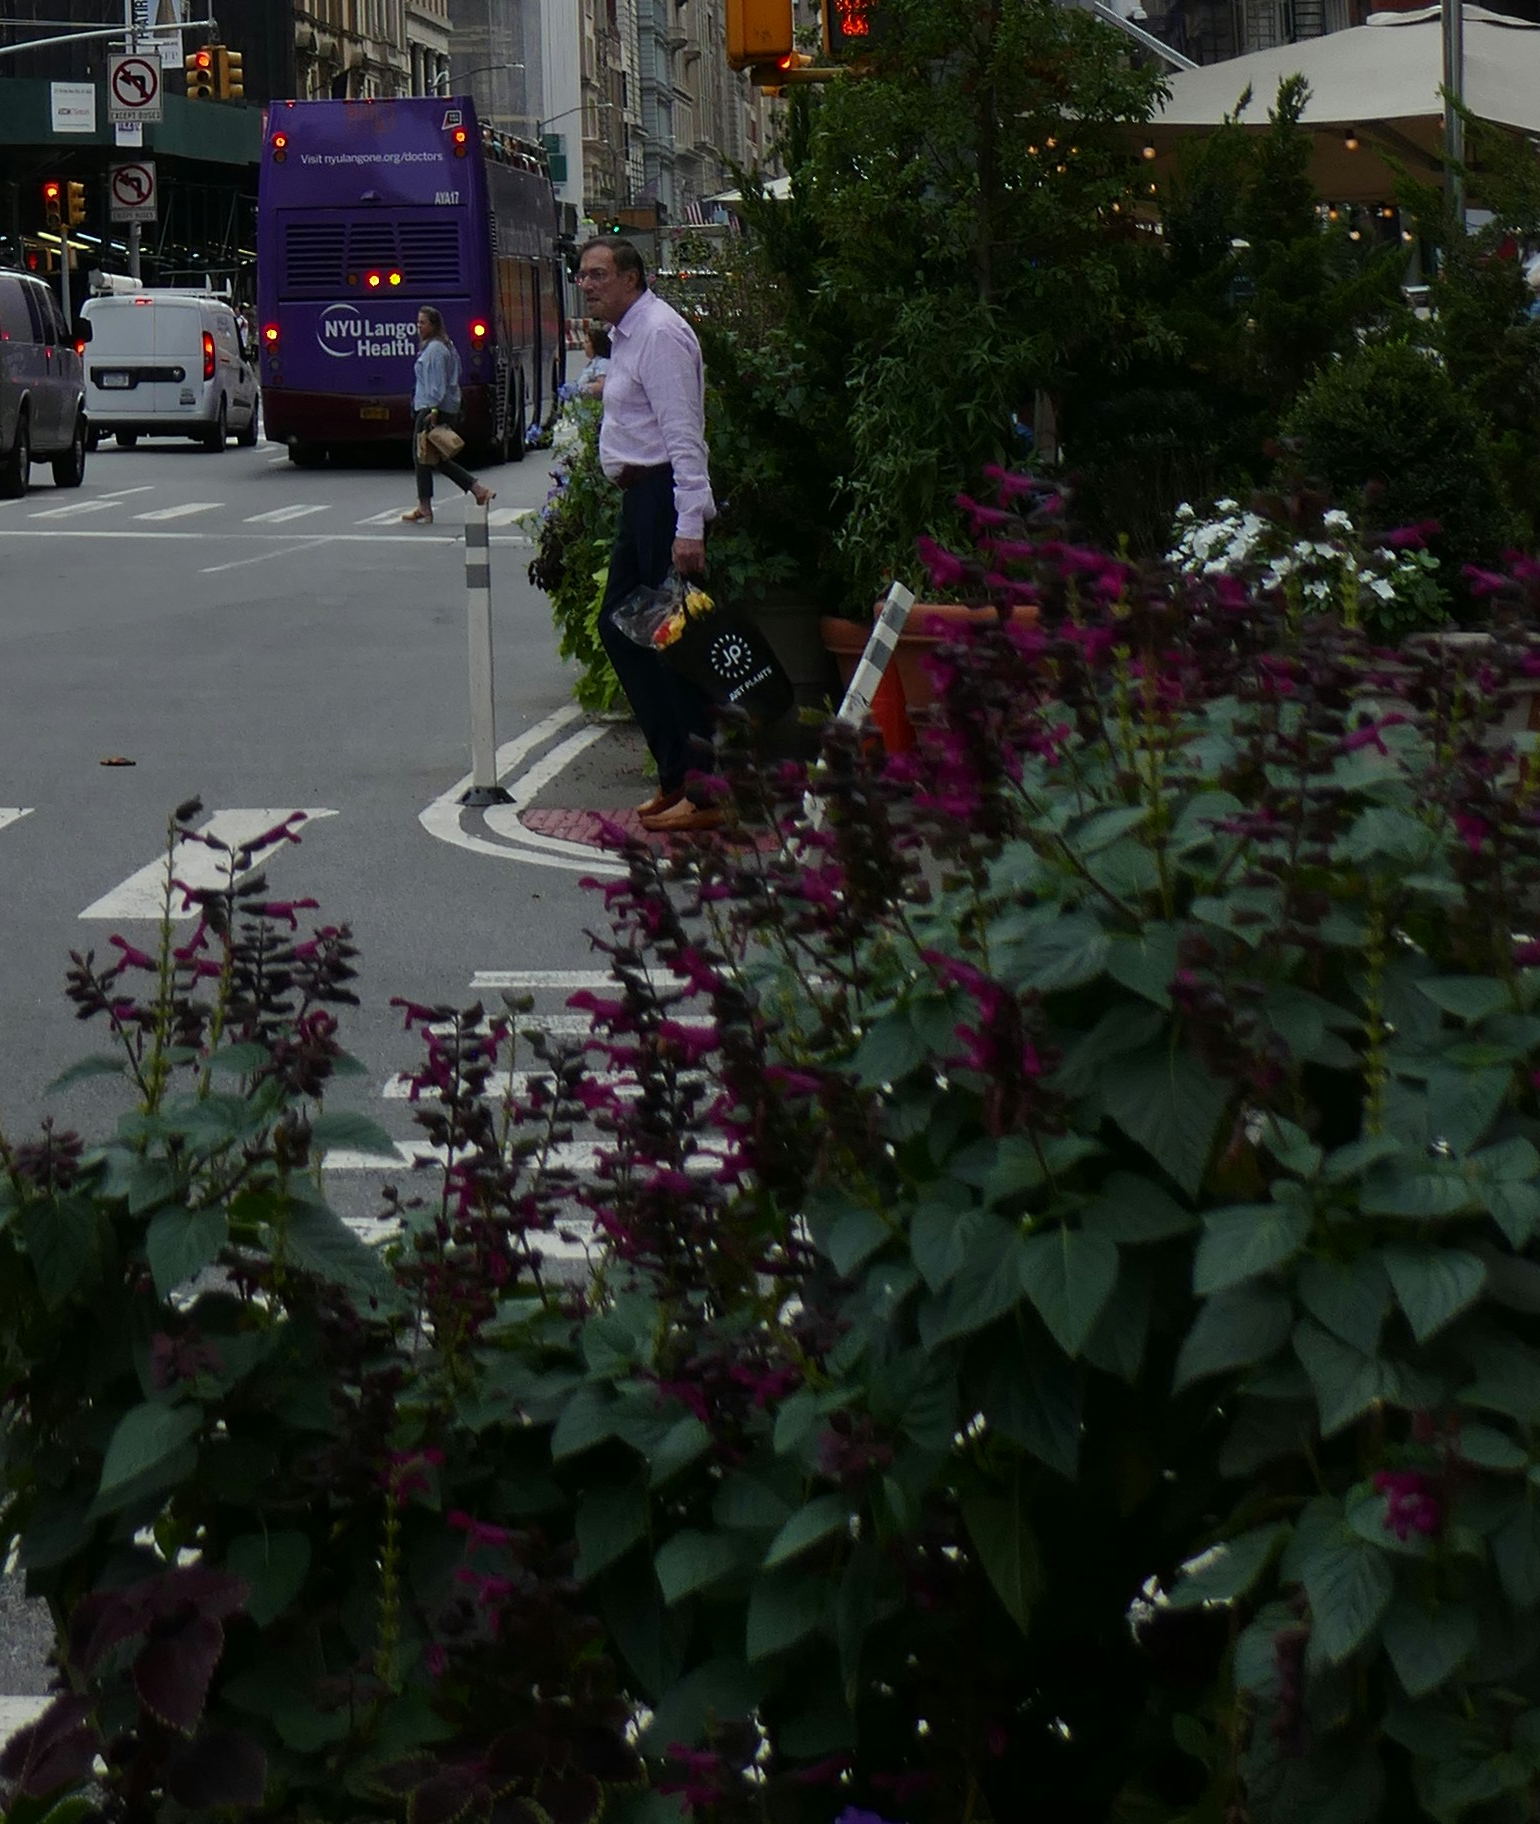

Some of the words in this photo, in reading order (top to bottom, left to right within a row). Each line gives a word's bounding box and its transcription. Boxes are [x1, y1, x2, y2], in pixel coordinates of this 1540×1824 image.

[300, 154, 323, 165] Visit
[324, 151, 444, 166] nyulangone.org/doctors
[434, 191, 460, 206] AYA17
[325, 320, 362, 338] NYU
[357, 338, 415, 357] Health
[722, 644, 742, 668] JP
[744, 664, 773, 690] PLANTS
